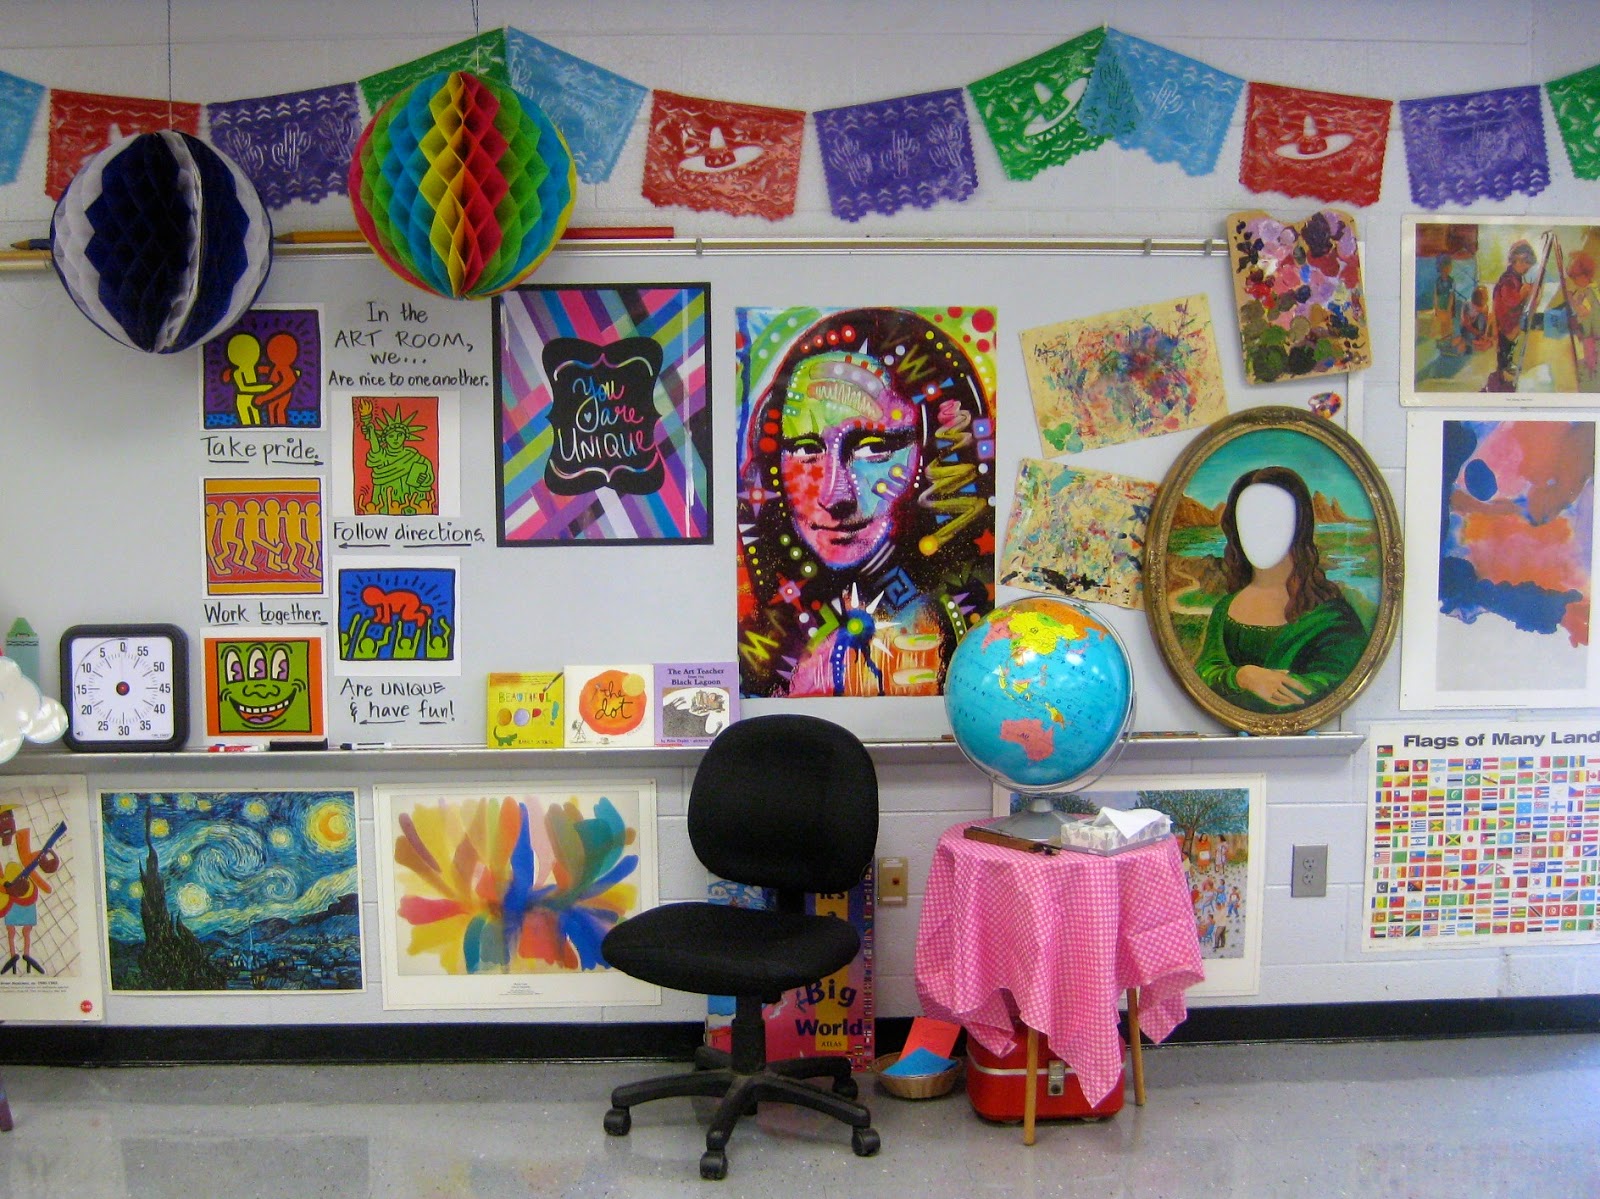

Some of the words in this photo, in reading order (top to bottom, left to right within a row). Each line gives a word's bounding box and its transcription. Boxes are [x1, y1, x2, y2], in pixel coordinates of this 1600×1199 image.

[366, 302, 389, 323] In
[400, 303, 428, 323] the
[334, 330, 383, 348] ART
[395, 330, 474, 352] ROOM,
[328, 370, 354, 386] Are
[359, 370, 386, 386] nice
[389, 371, 405, 386] to
[572, 376, 625, 433] You
[600, 404, 644, 426] are
[200, 436, 258, 458] Take
[263, 438, 320, 466] pride.
[333, 521, 389, 542] Follow
[204, 603, 250, 623] Work
[260, 602, 322, 625] together.
[99, 647, 106, 658] 5
[120, 641, 126, 652] 0
[137, 646, 149, 657] 55
[82, 662, 92, 673] 10
[153, 661, 165, 672] 50
[697, 667, 725, 675] Teacher
[76, 684, 87, 695] 15
[159, 683, 171, 694] 45
[340, 678, 373, 697] Are
[380, 680, 446, 697] UNIQUE
[600, 680, 626, 699] the
[694, 679, 722, 687] Lagoon
[81, 704, 92, 715] 20
[153, 703, 165, 714] 40
[368, 702, 410, 719] have
[419, 700, 455, 721] fun!
[595, 697, 634, 720] dot
[98, 720, 109, 731] 25
[118, 725, 130, 736] 30
[140, 720, 151, 731] 35
[1403, 734, 1459, 750] Flags
[1465, 733, 1485, 747] of
[1491, 732, 1546, 748] Many
[804, 978, 857, 1008] Big
[794, 1018, 864, 1036] World
